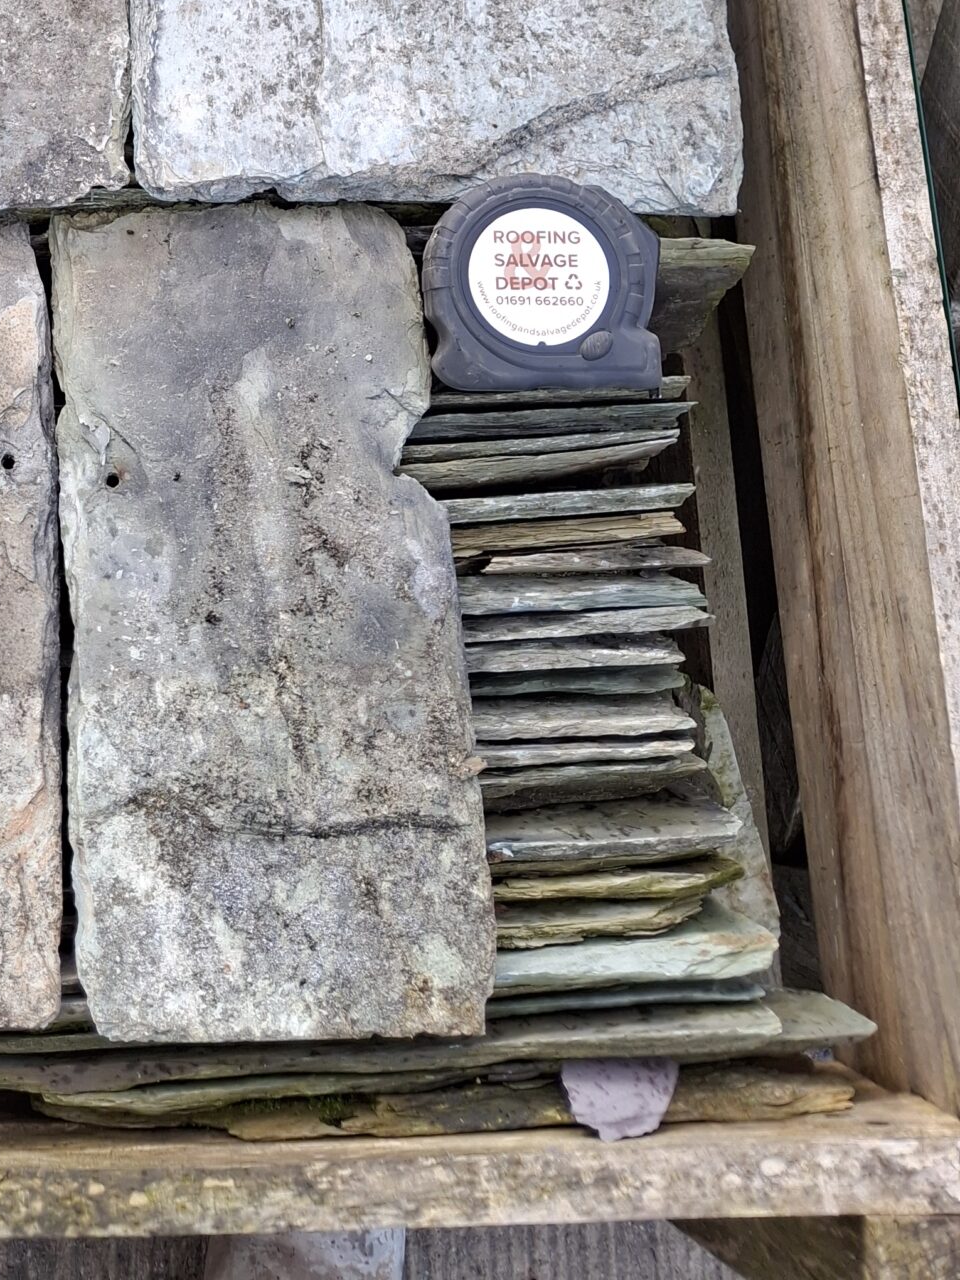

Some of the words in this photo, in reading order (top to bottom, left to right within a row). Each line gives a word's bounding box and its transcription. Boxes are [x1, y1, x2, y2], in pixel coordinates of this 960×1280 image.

[493, 230, 581, 244] ROOFING
[494, 253, 578, 267] SALVAGE
[495, 277, 558, 290] DEPOT
[496, 296, 531, 305] 01691
[535, 296, 584, 306] 662660
